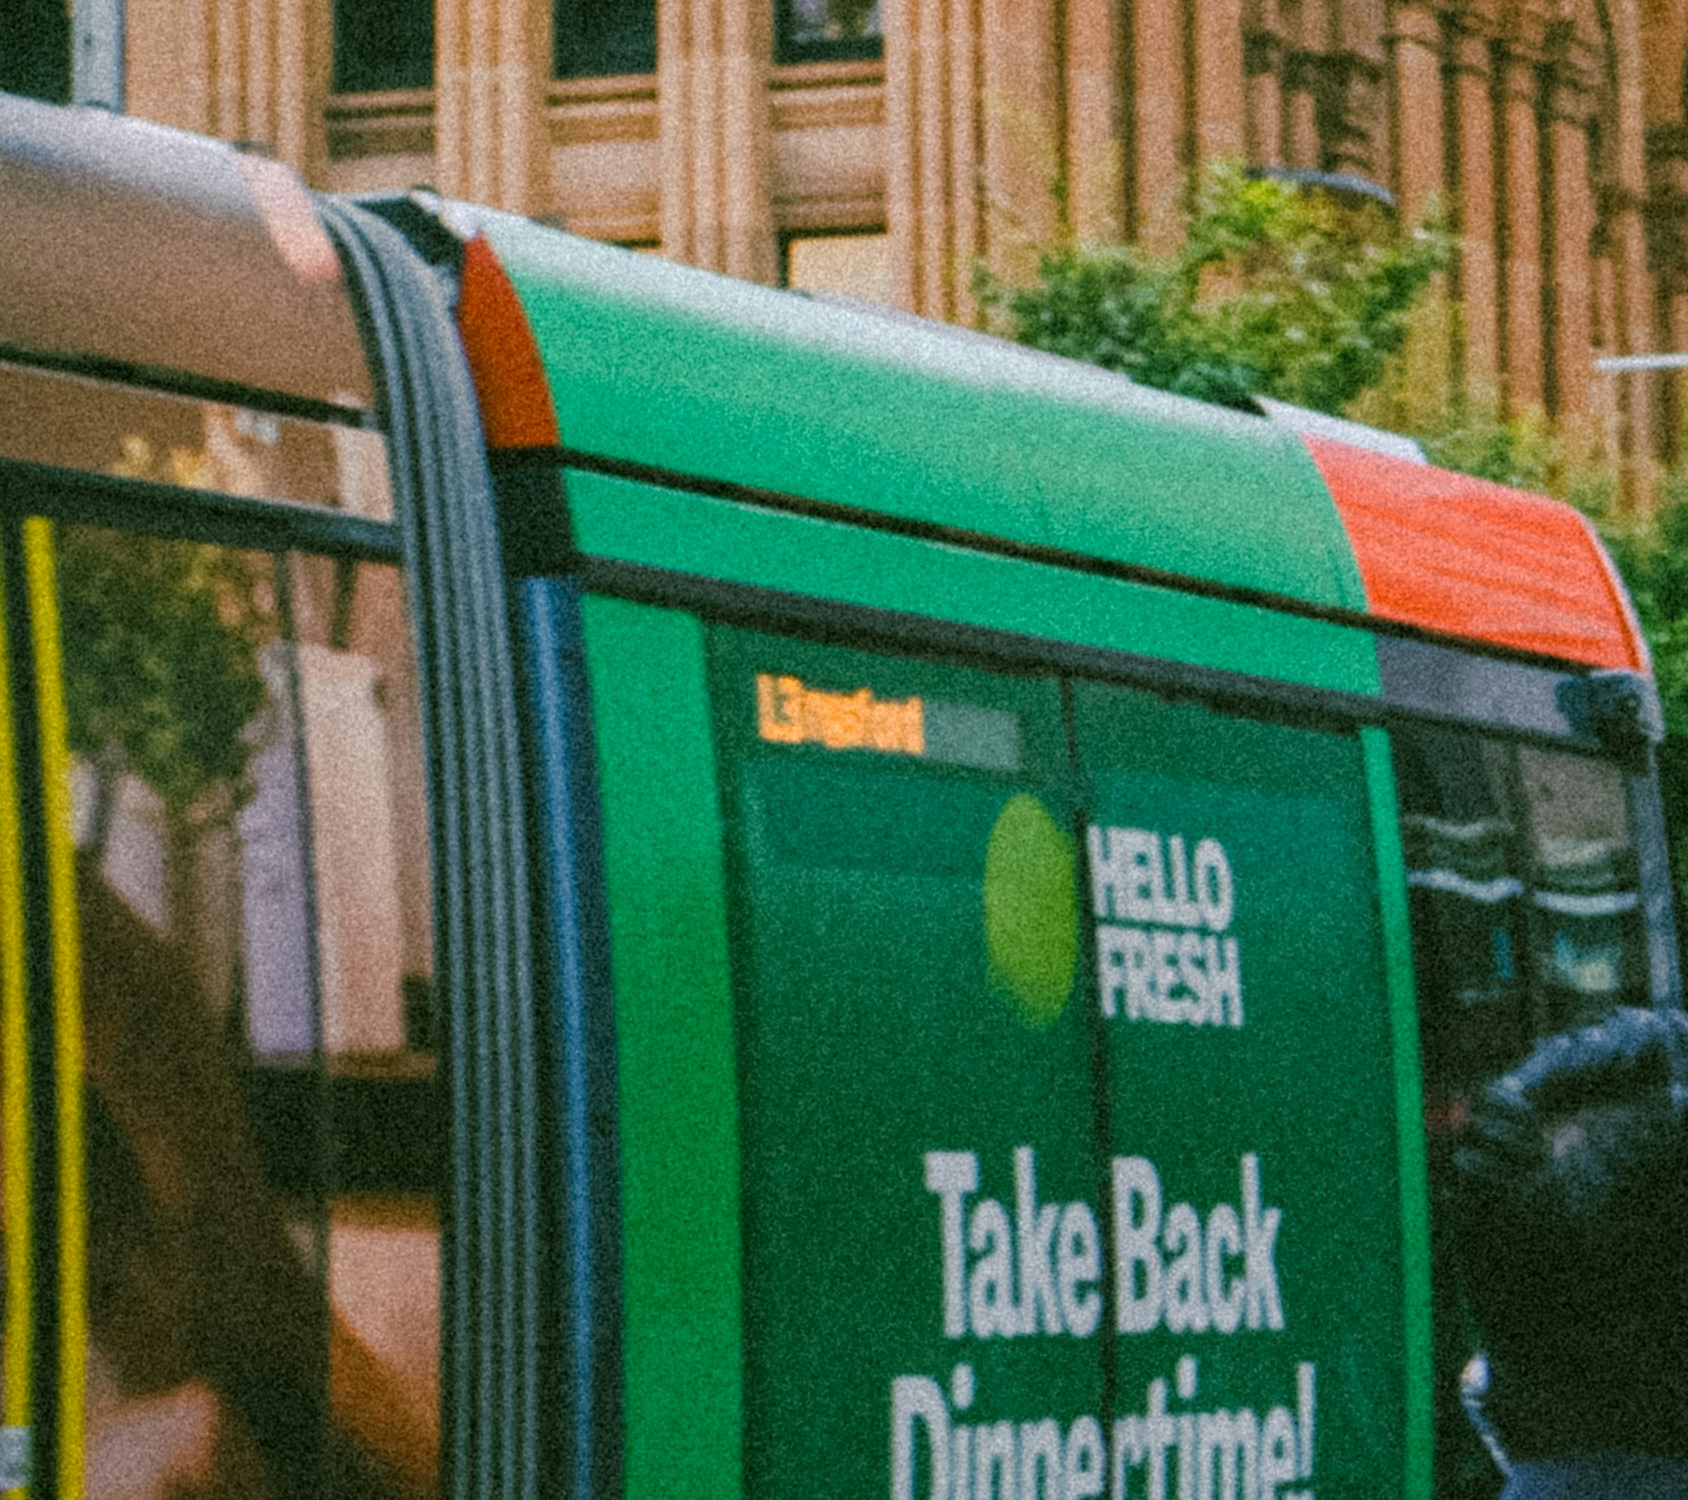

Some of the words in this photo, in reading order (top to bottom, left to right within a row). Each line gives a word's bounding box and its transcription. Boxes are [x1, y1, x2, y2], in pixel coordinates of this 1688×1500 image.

[1088, 826, 1234, 931] HELLO
[1096, 924, 1243, 1027] FRESH
[924, 1146, 1103, 1338] Take
[1111, 1153, 1285, 1334] Back
